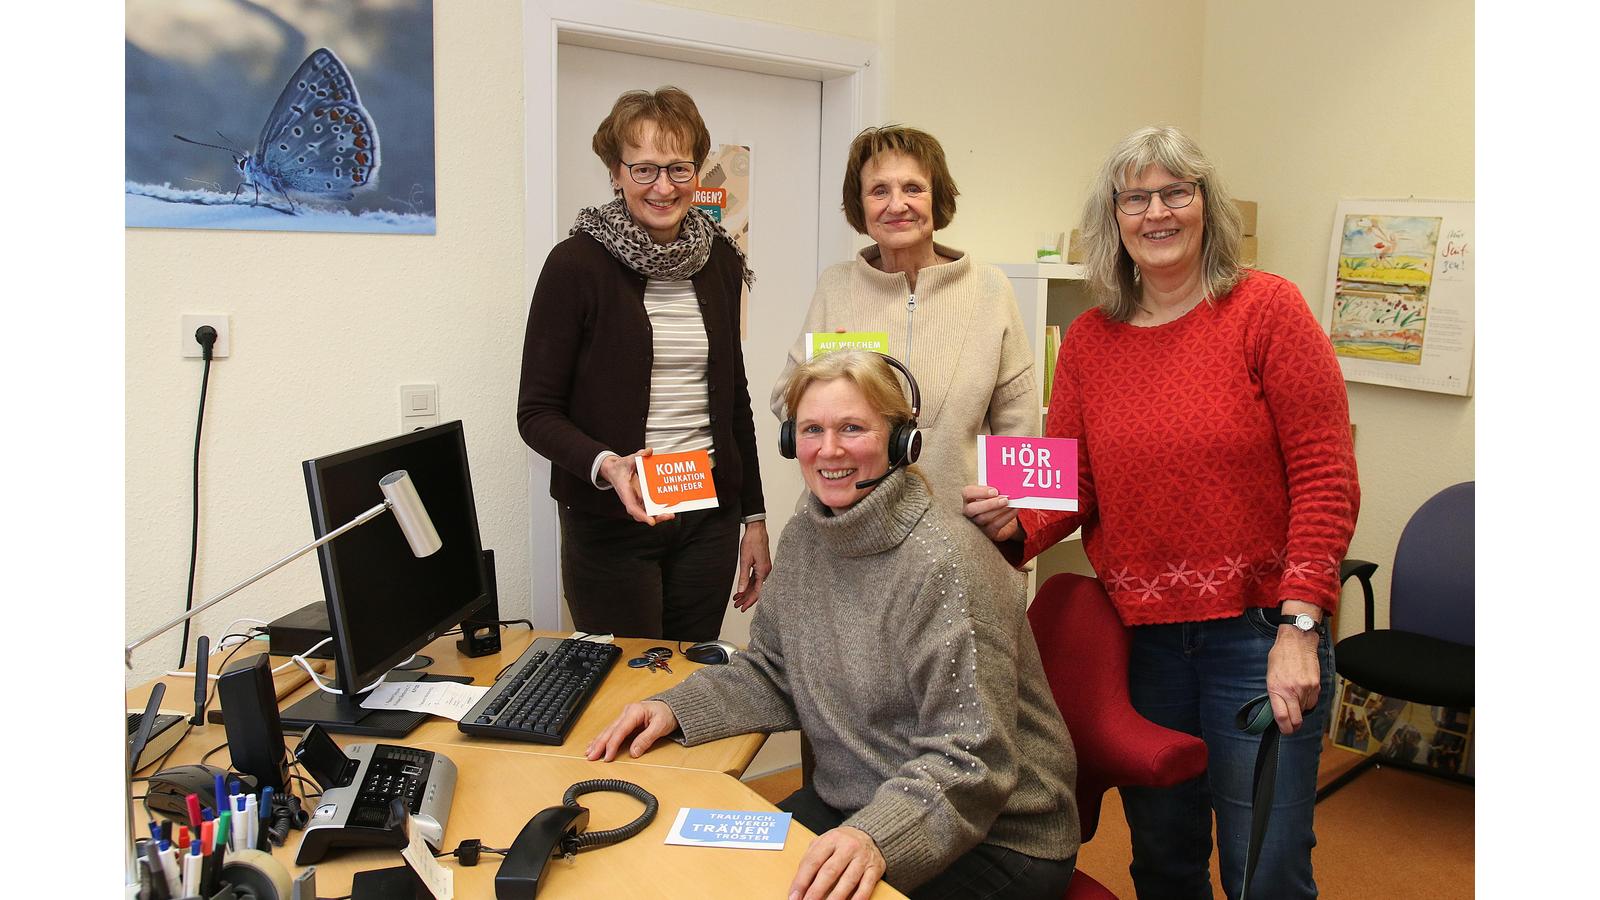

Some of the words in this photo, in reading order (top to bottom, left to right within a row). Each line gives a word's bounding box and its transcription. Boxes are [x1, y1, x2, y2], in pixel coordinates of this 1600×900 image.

[839, 341, 881, 349] WELCHEM
[1001, 443, 1052, 468] HÖR
[655, 460, 697, 476] KOMM
[663, 472, 705, 484] UNIKATION
[1022, 468, 1061, 489] ZU!
[657, 484, 679, 494] KANN
[680, 481, 704, 493] JEDER
[692, 823, 769, 835] TRÄNEN
[735, 820, 776, 828] WERDE
[715, 832, 770, 841] TRÖSTER
